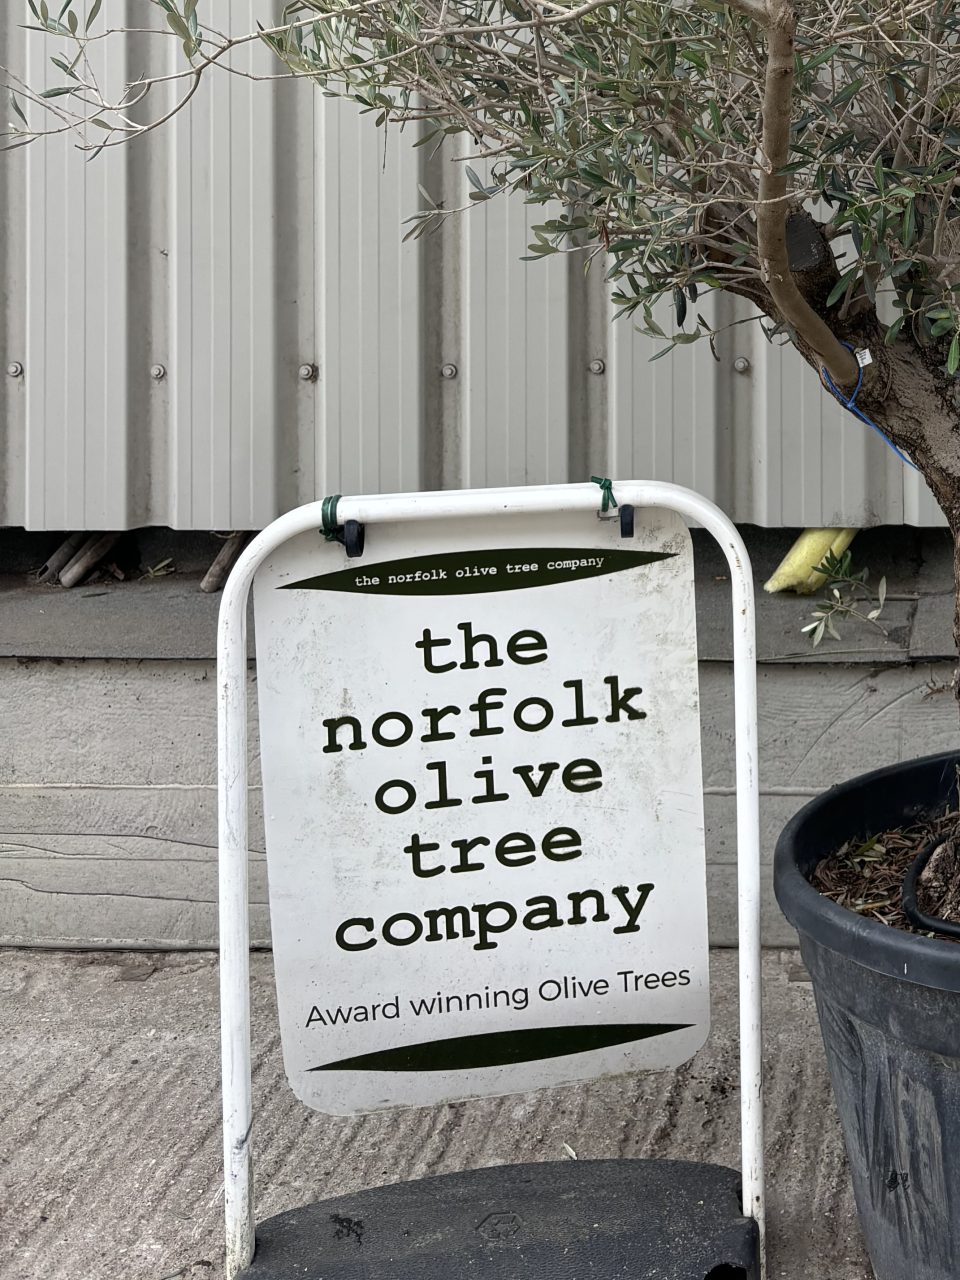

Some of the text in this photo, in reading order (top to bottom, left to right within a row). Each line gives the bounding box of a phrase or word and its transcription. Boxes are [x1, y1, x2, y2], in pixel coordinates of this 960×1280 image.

[355, 556, 605, 587] the norfolk olive tree company
[415, 622, 548, 674] the
[322, 676, 647, 753] norfolk
[374, 756, 603, 815] olive
[403, 826, 583, 878] tree
[335, 883, 654, 952] company
[305, 969, 691, 1028] Award winning Olive Trees
